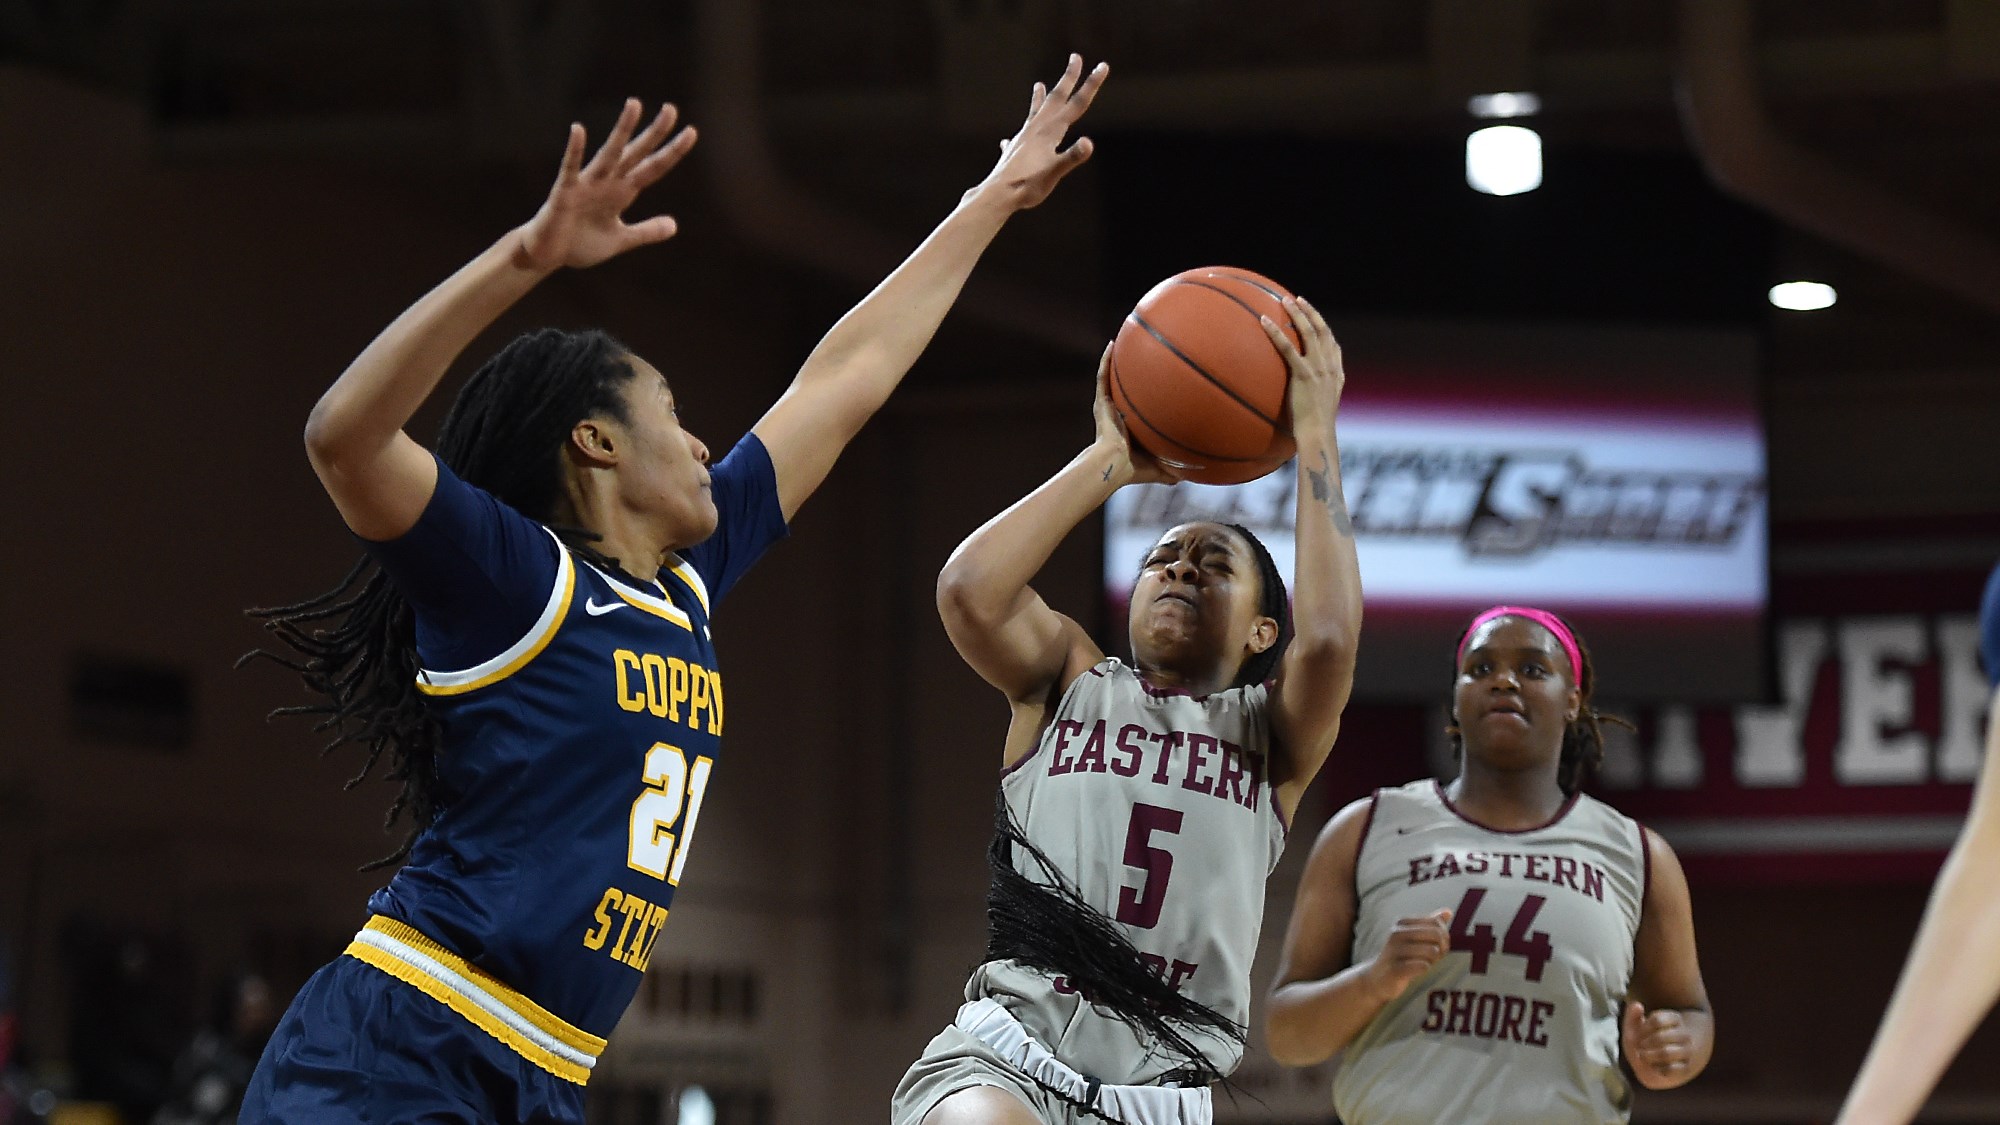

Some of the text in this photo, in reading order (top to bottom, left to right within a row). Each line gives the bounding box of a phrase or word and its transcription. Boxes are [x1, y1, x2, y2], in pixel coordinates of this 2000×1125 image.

[1048, 719, 1265, 814] EASTERN
[627, 741, 713, 888] 21
[1116, 801, 1184, 930] 5
[1408, 852, 1605, 903] EASTERN
[1449, 888, 1553, 982] 44
[1421, 990, 1555, 1048] SHORE
